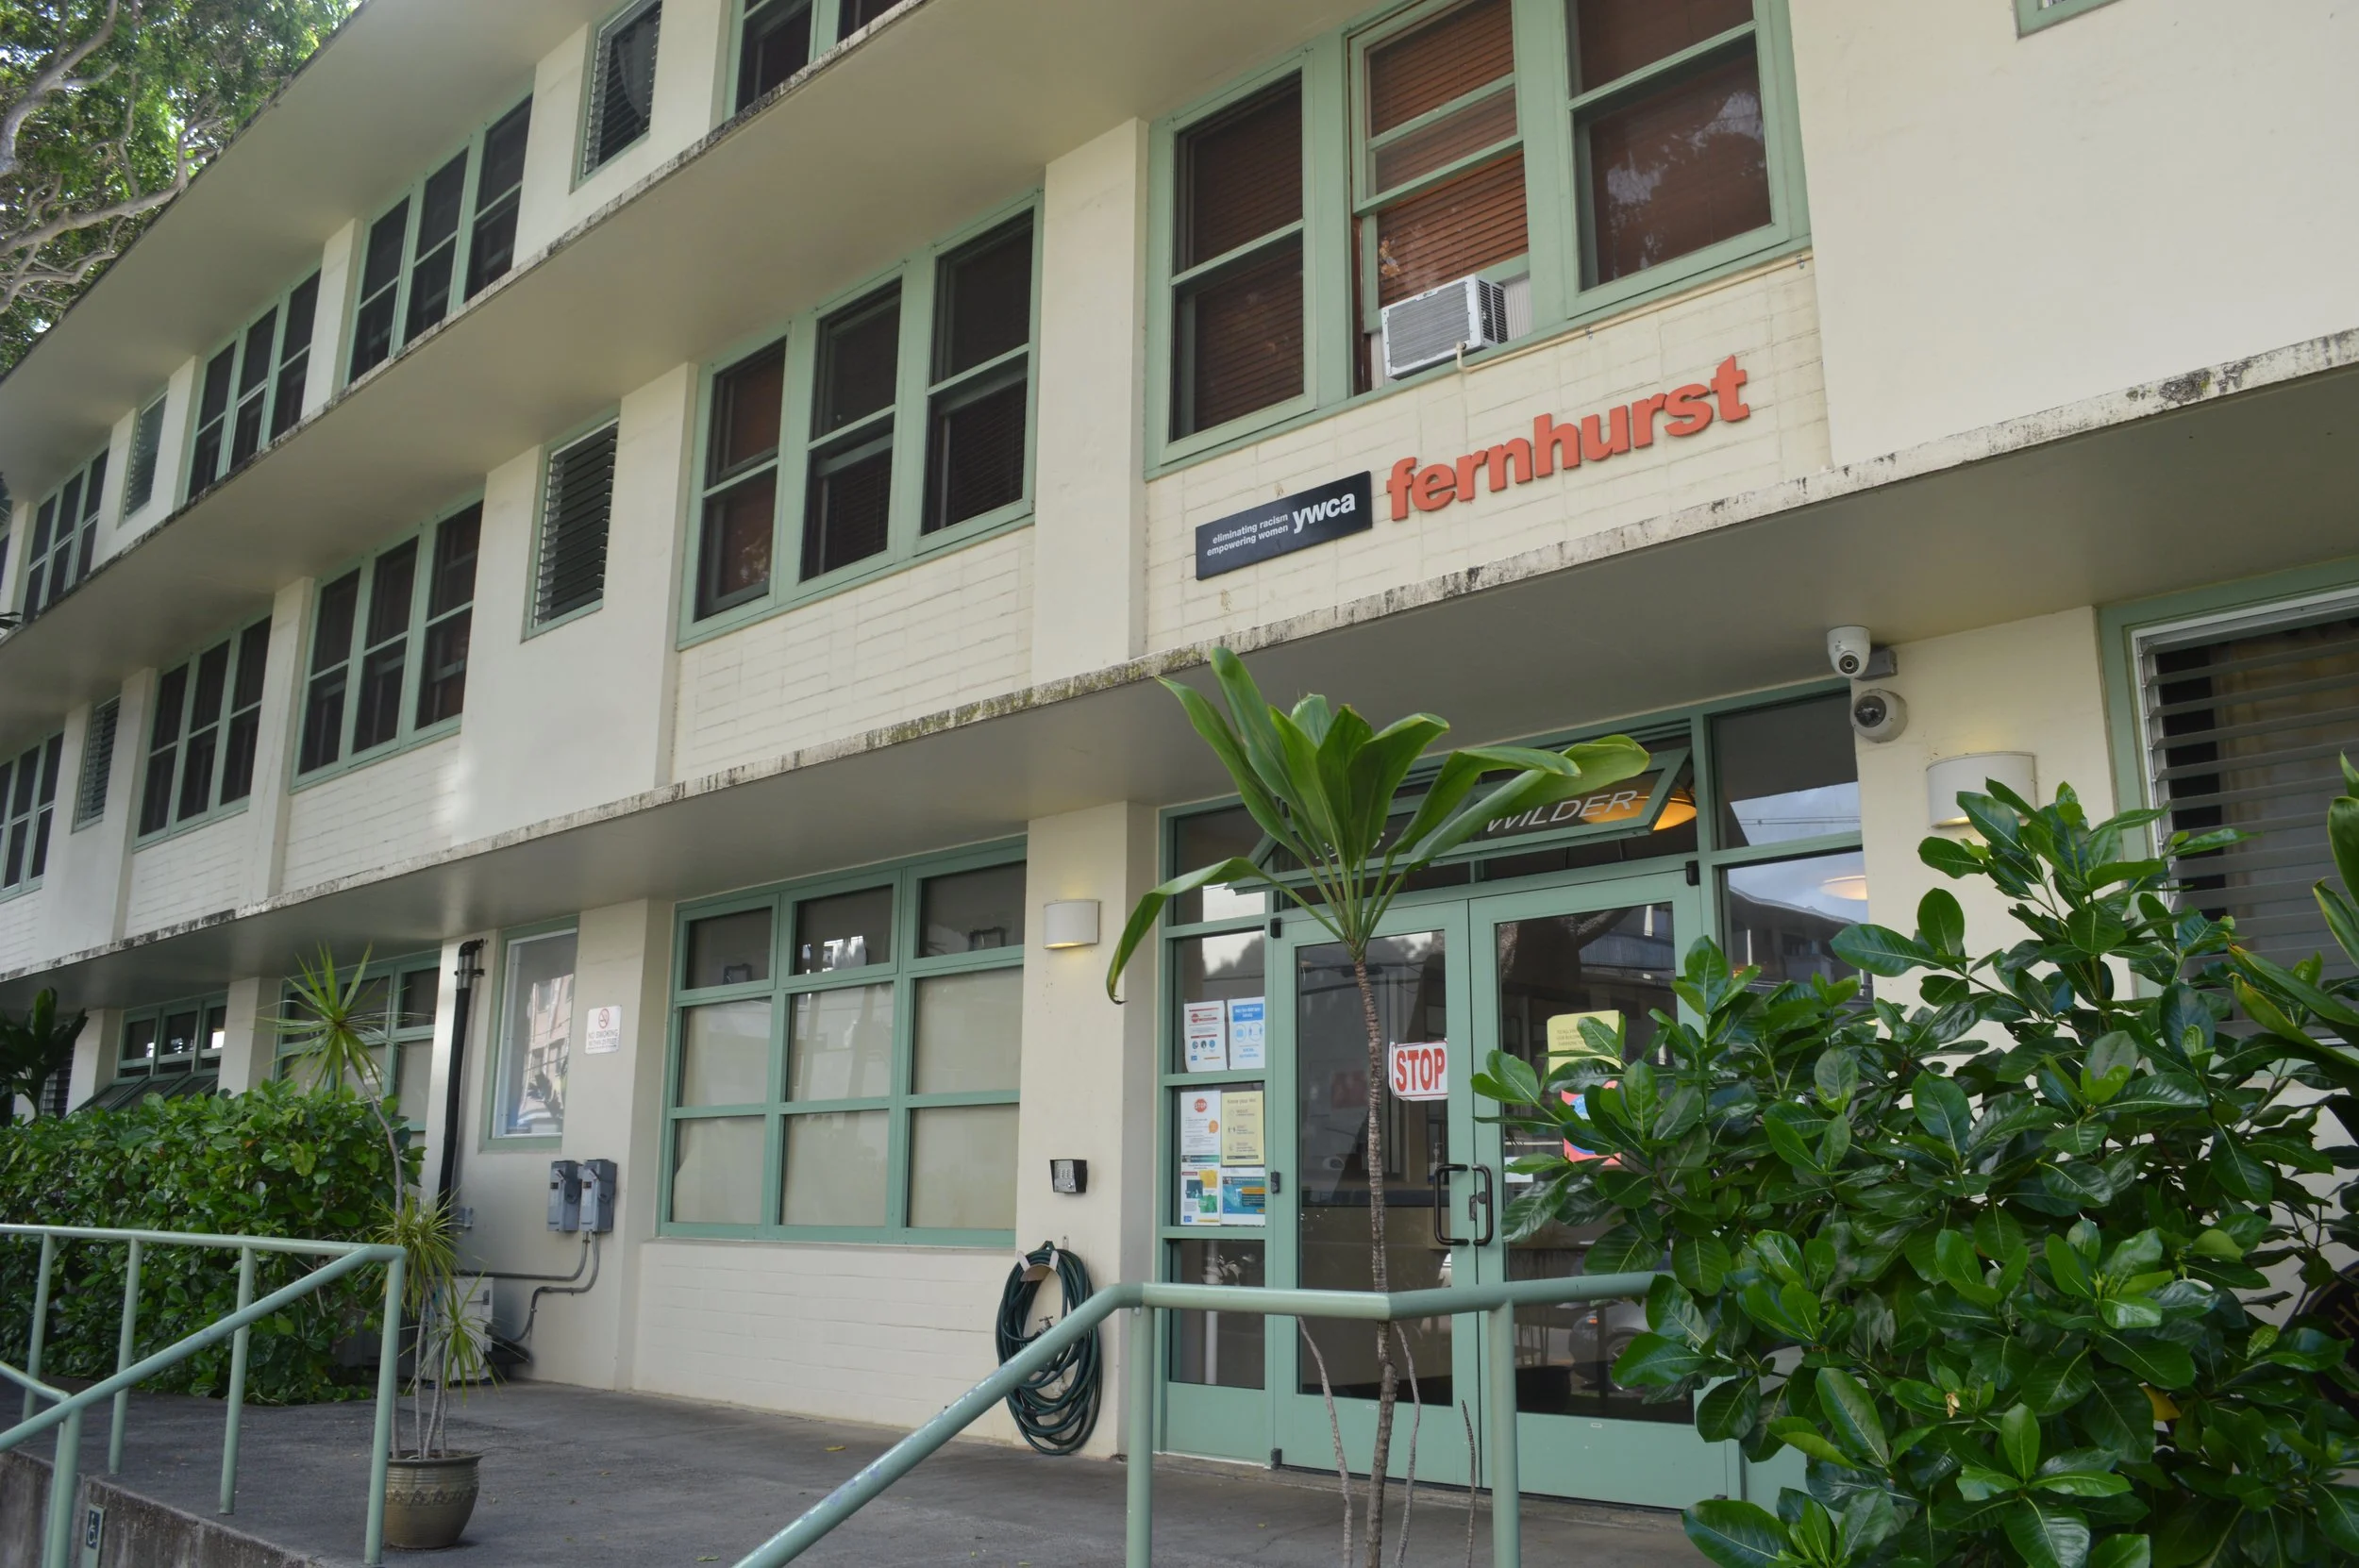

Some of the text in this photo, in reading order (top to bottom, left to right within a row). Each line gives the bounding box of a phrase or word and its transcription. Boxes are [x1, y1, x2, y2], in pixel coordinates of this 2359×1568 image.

[1386, 355, 1750, 521] fernhurst
[1212, 512, 1289, 544] eliminating racism
[1292, 492, 1356, 535] ywca
[1206, 525, 1289, 557] empowering women
[595, 1028, 619, 1039] SMOKING
[1396, 1047, 1446, 1093] STOP
